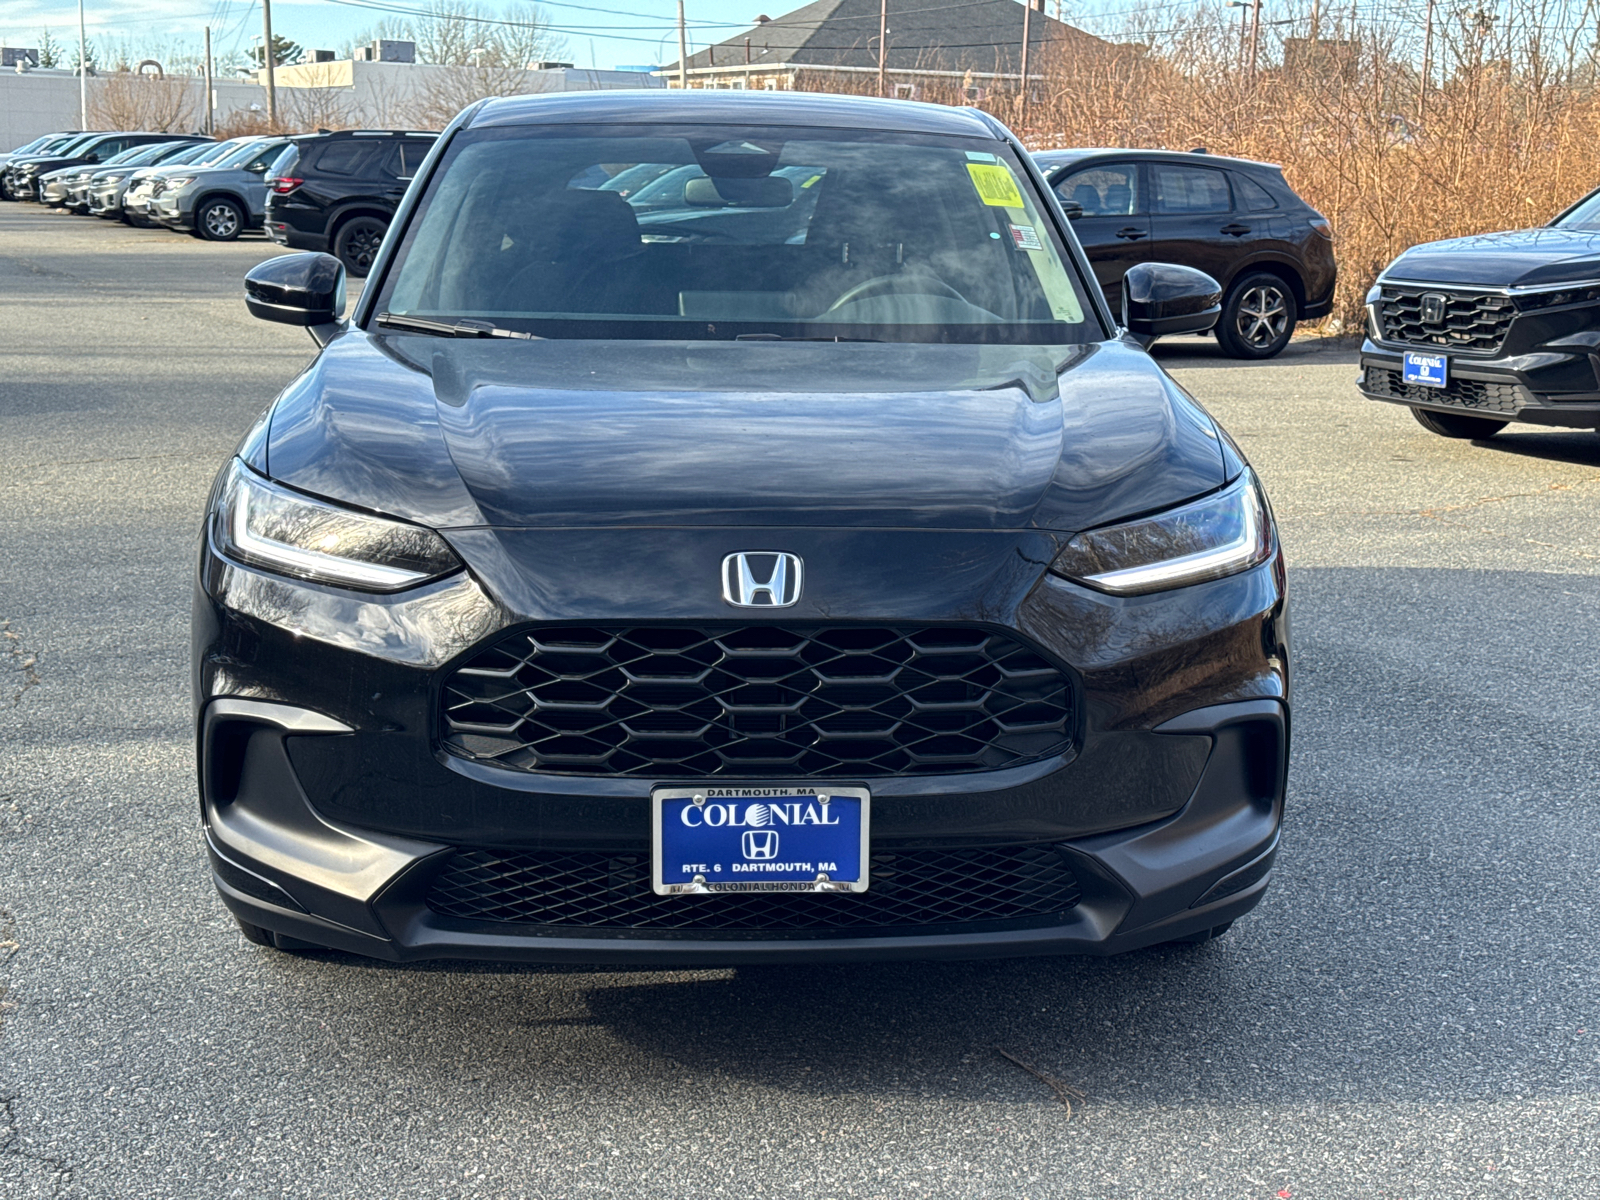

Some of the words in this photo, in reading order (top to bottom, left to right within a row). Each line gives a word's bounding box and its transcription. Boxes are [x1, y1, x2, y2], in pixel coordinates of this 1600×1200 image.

[681, 802, 840, 827] COLONIAL
[682, 864, 711, 873] RTE.
[713, 864, 722, 872] 6
[732, 862, 815, 873] DARTMOUTH,
[818, 862, 838, 871] MA
[707, 882, 768, 892] COLONIAL
[771, 882, 816, 891] HONDA
